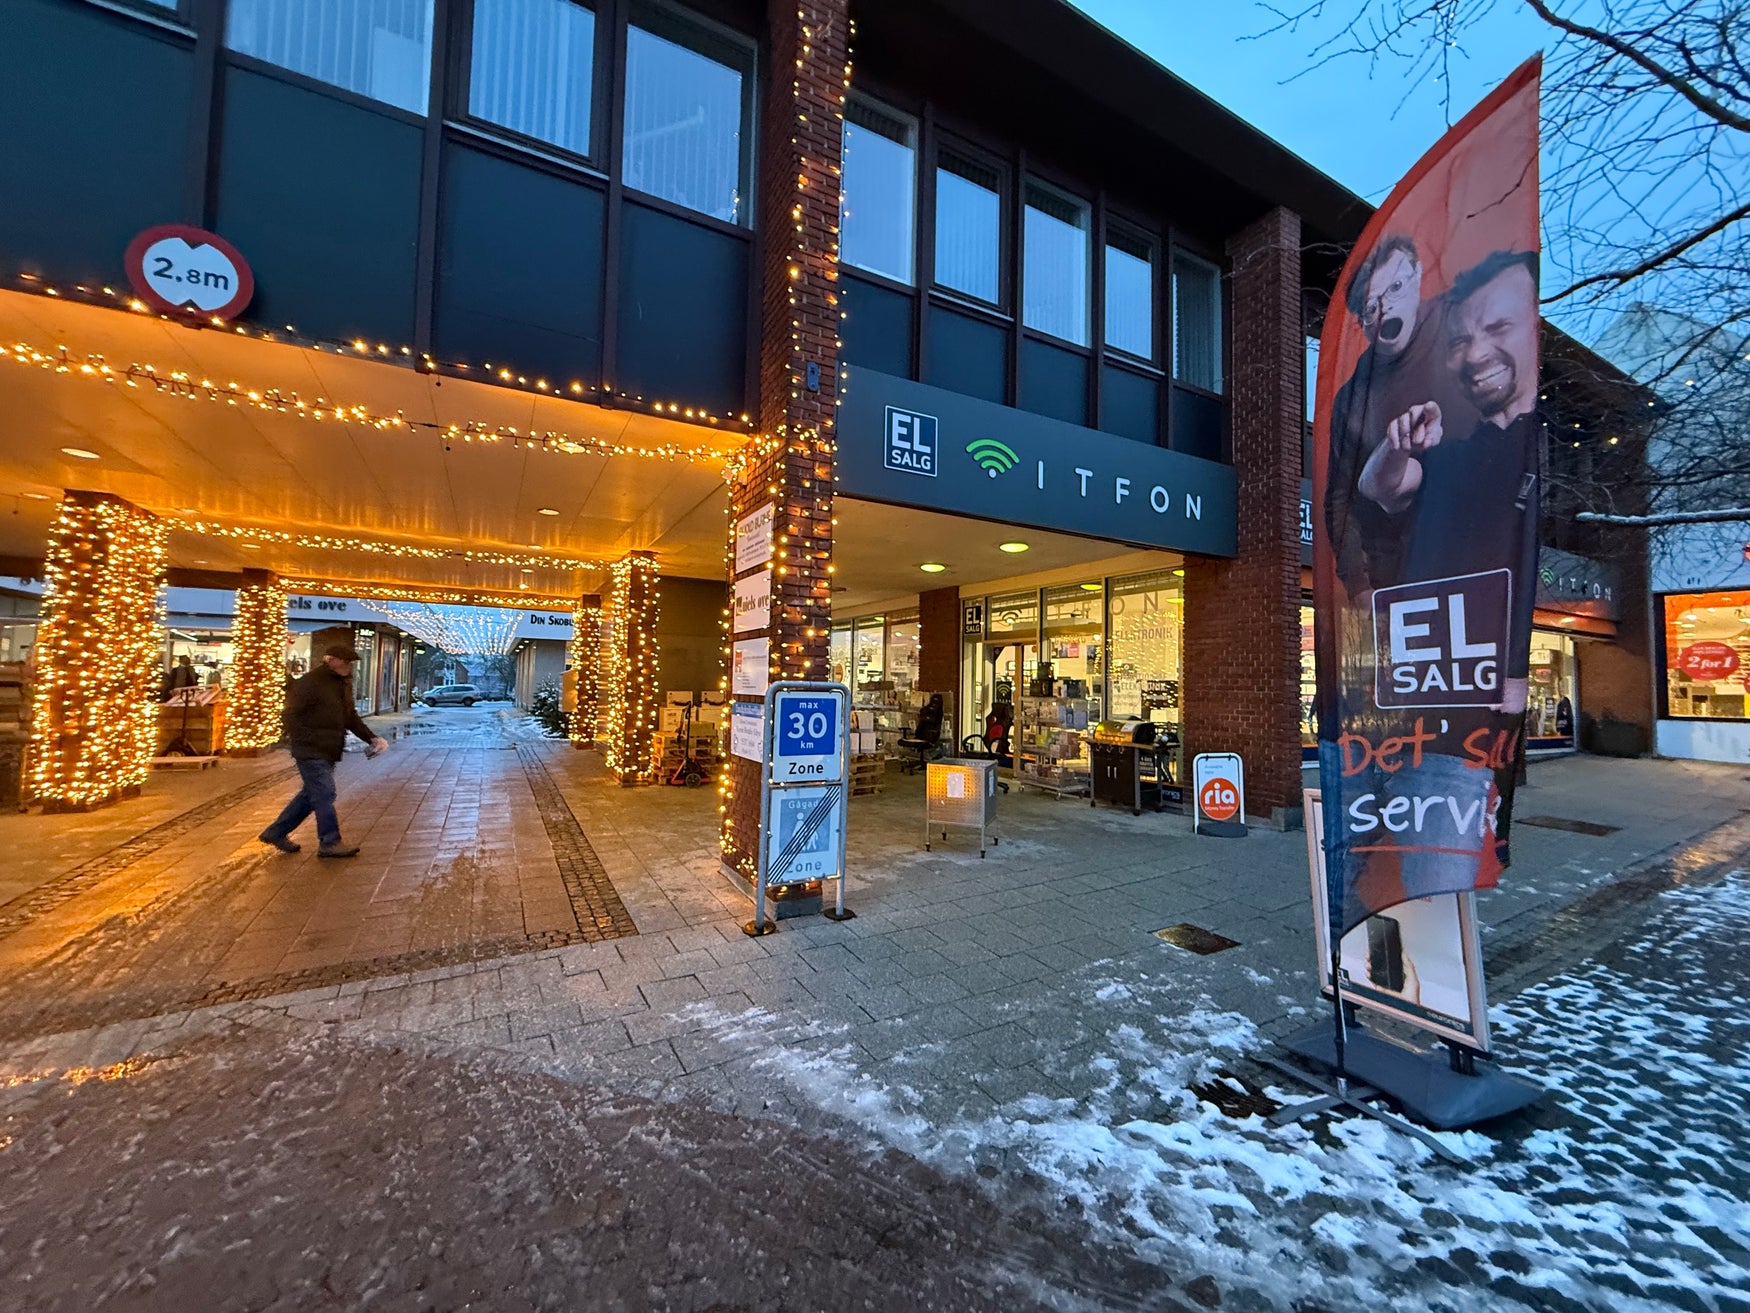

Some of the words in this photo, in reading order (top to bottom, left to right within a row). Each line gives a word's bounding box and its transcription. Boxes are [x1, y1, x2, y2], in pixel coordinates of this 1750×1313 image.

[153, 257, 229, 291] 2.8m
[892, 412, 932, 454] EL
[891, 449, 932, 471] SALG
[1037, 460, 1202, 521] ITFON
[317, 600, 347, 612] ove
[965, 607, 980, 625] EL
[965, 624, 980, 633] SALG
[1389, 593, 1497, 664] EL
[1686, 655, 1701, 668] 2
[1700, 659, 1722, 670] for
[1723, 656, 1733, 668] 1
[1392, 660, 1497, 694] SALG
[787, 712, 828, 739] 30
[800, 741, 814, 749] km
[788, 762, 824, 775] Zone
[1204, 782, 1235, 804] ria
